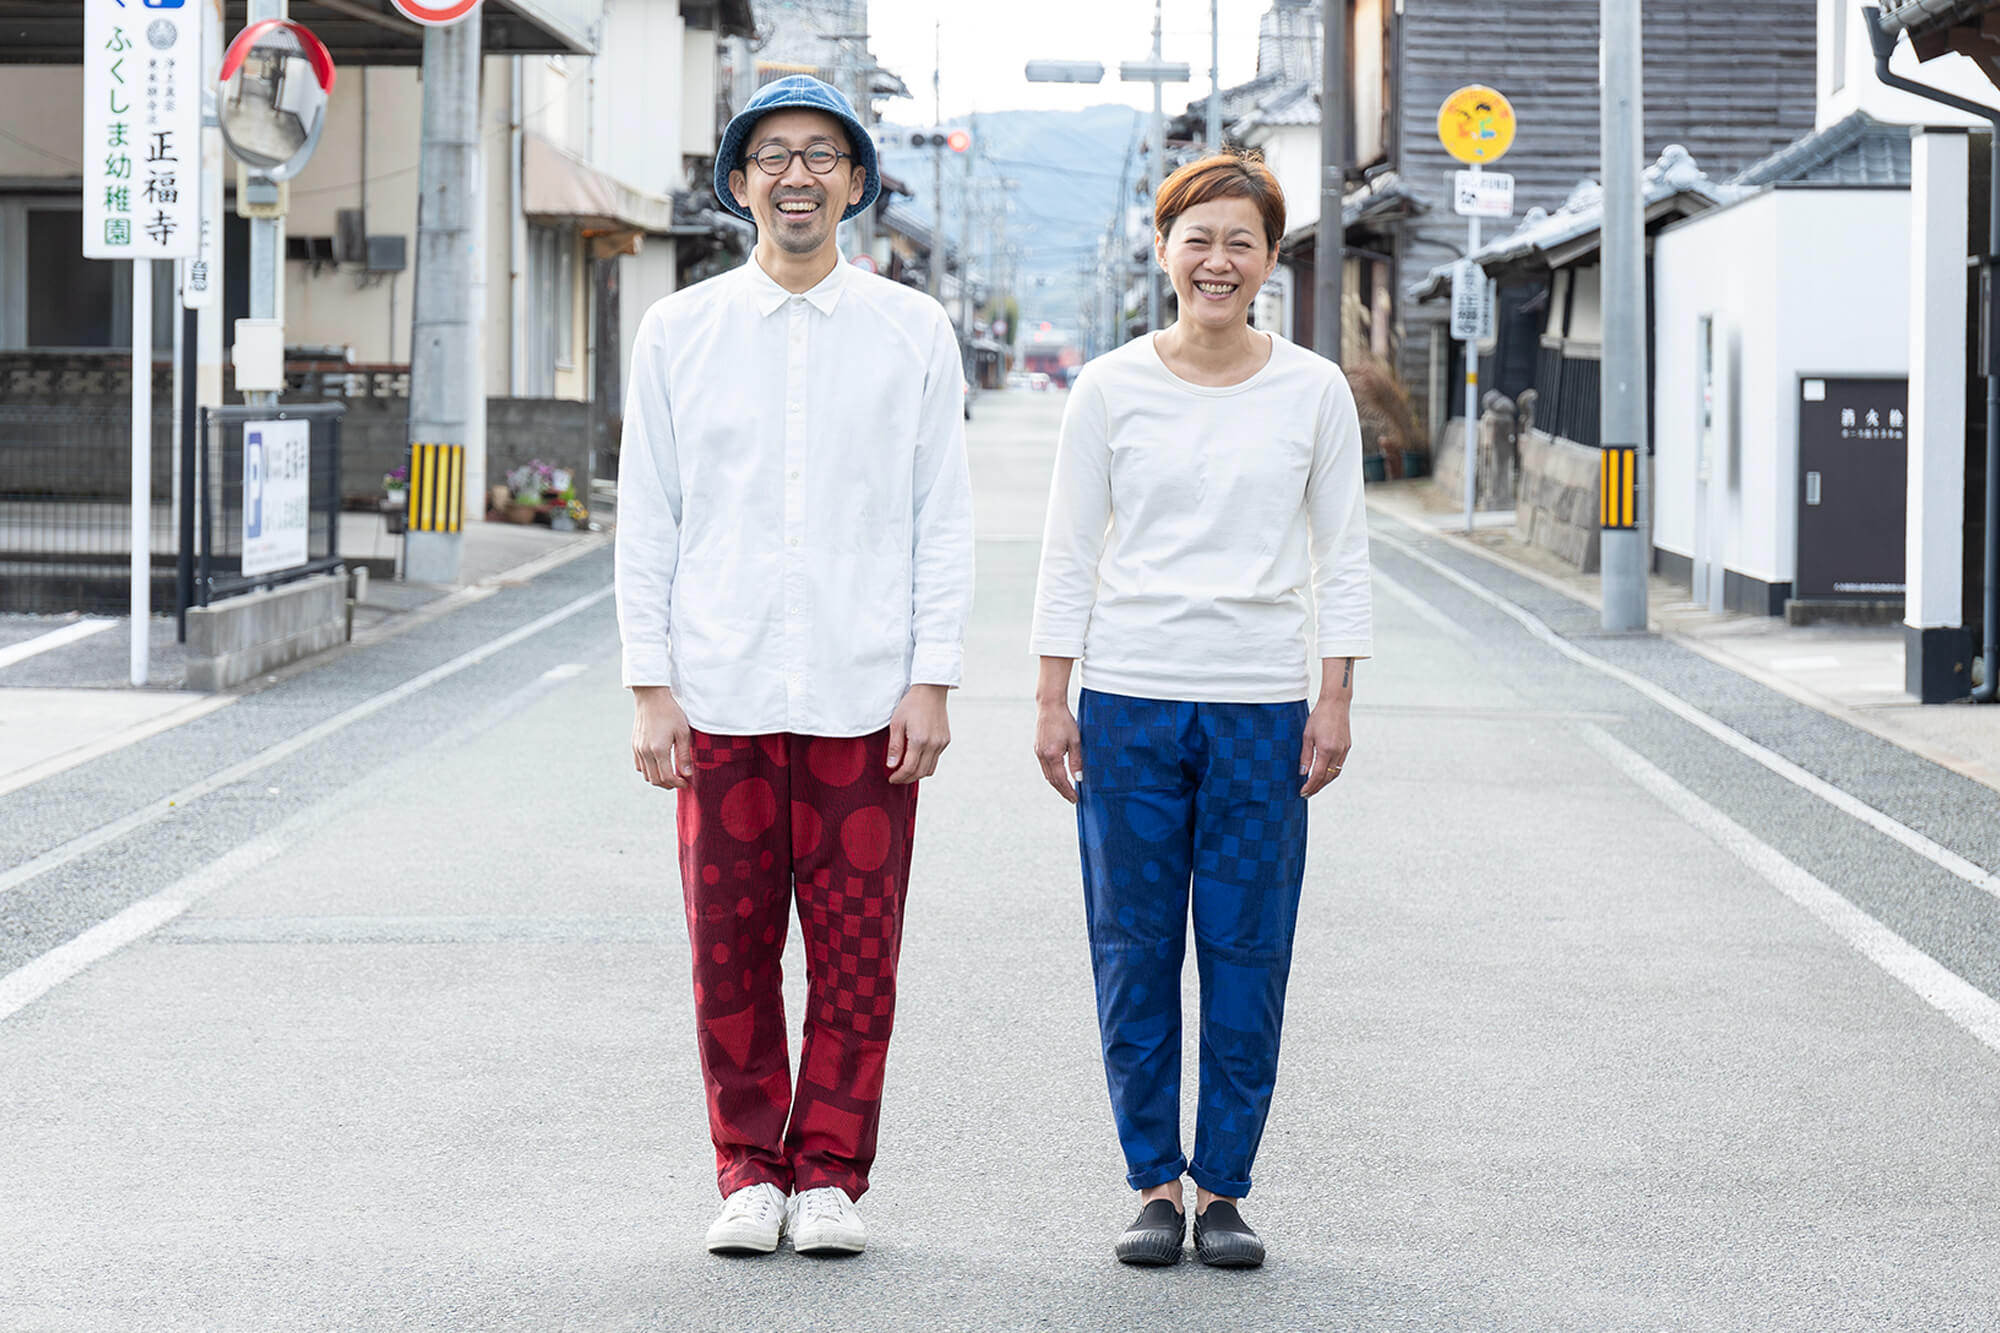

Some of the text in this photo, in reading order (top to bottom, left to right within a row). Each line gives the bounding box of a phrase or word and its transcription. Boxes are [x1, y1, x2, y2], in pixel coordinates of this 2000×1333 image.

[103, 26, 132, 245] ふくしま幼稚園
[142, 131, 178, 246] 正福寺
